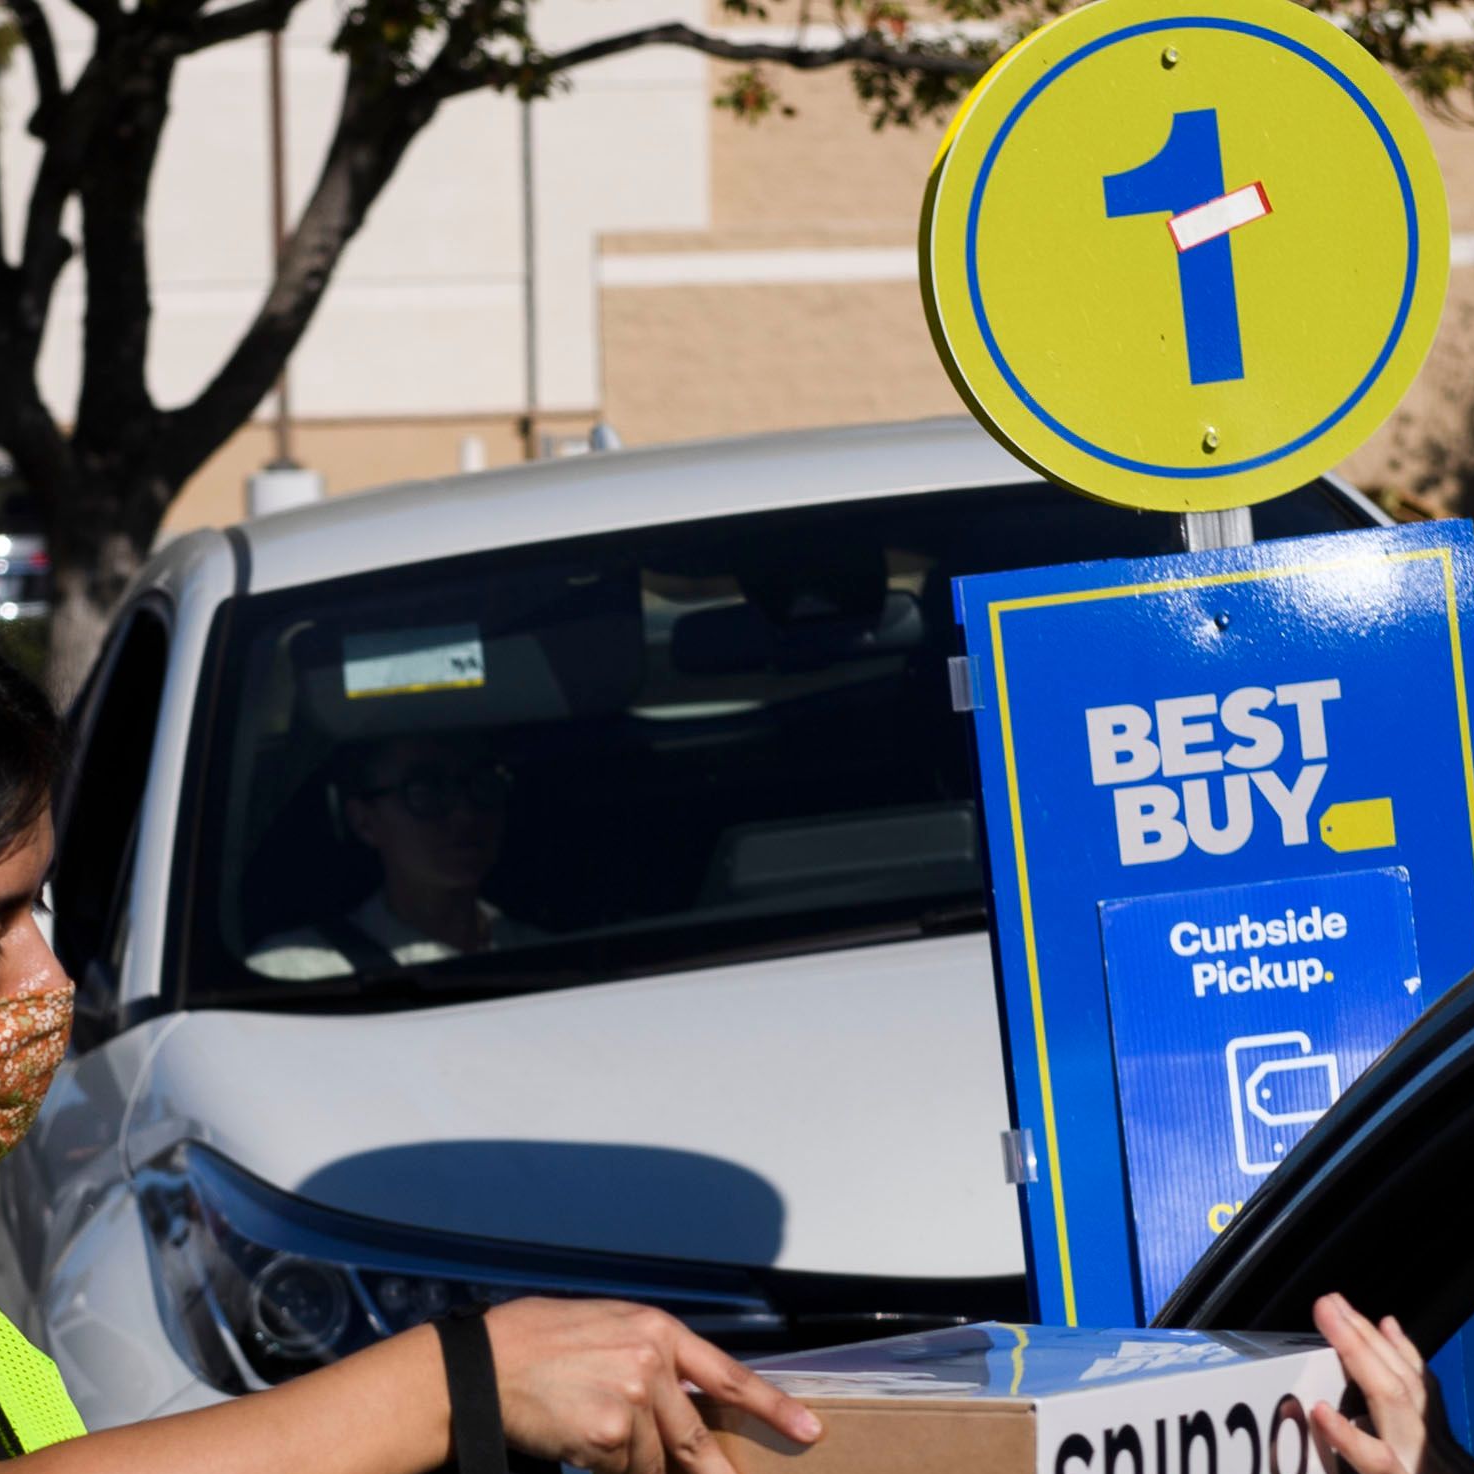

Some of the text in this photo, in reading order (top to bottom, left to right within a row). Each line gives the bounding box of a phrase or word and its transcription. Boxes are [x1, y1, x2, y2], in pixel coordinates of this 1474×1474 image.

[1102, 107, 1245, 386] 1
[1084, 678, 1342, 787] BEST
[1113, 763, 1328, 866] BUY
[1169, 905, 1348, 957] Curbside
[1191, 946, 1334, 998] Pickup.
